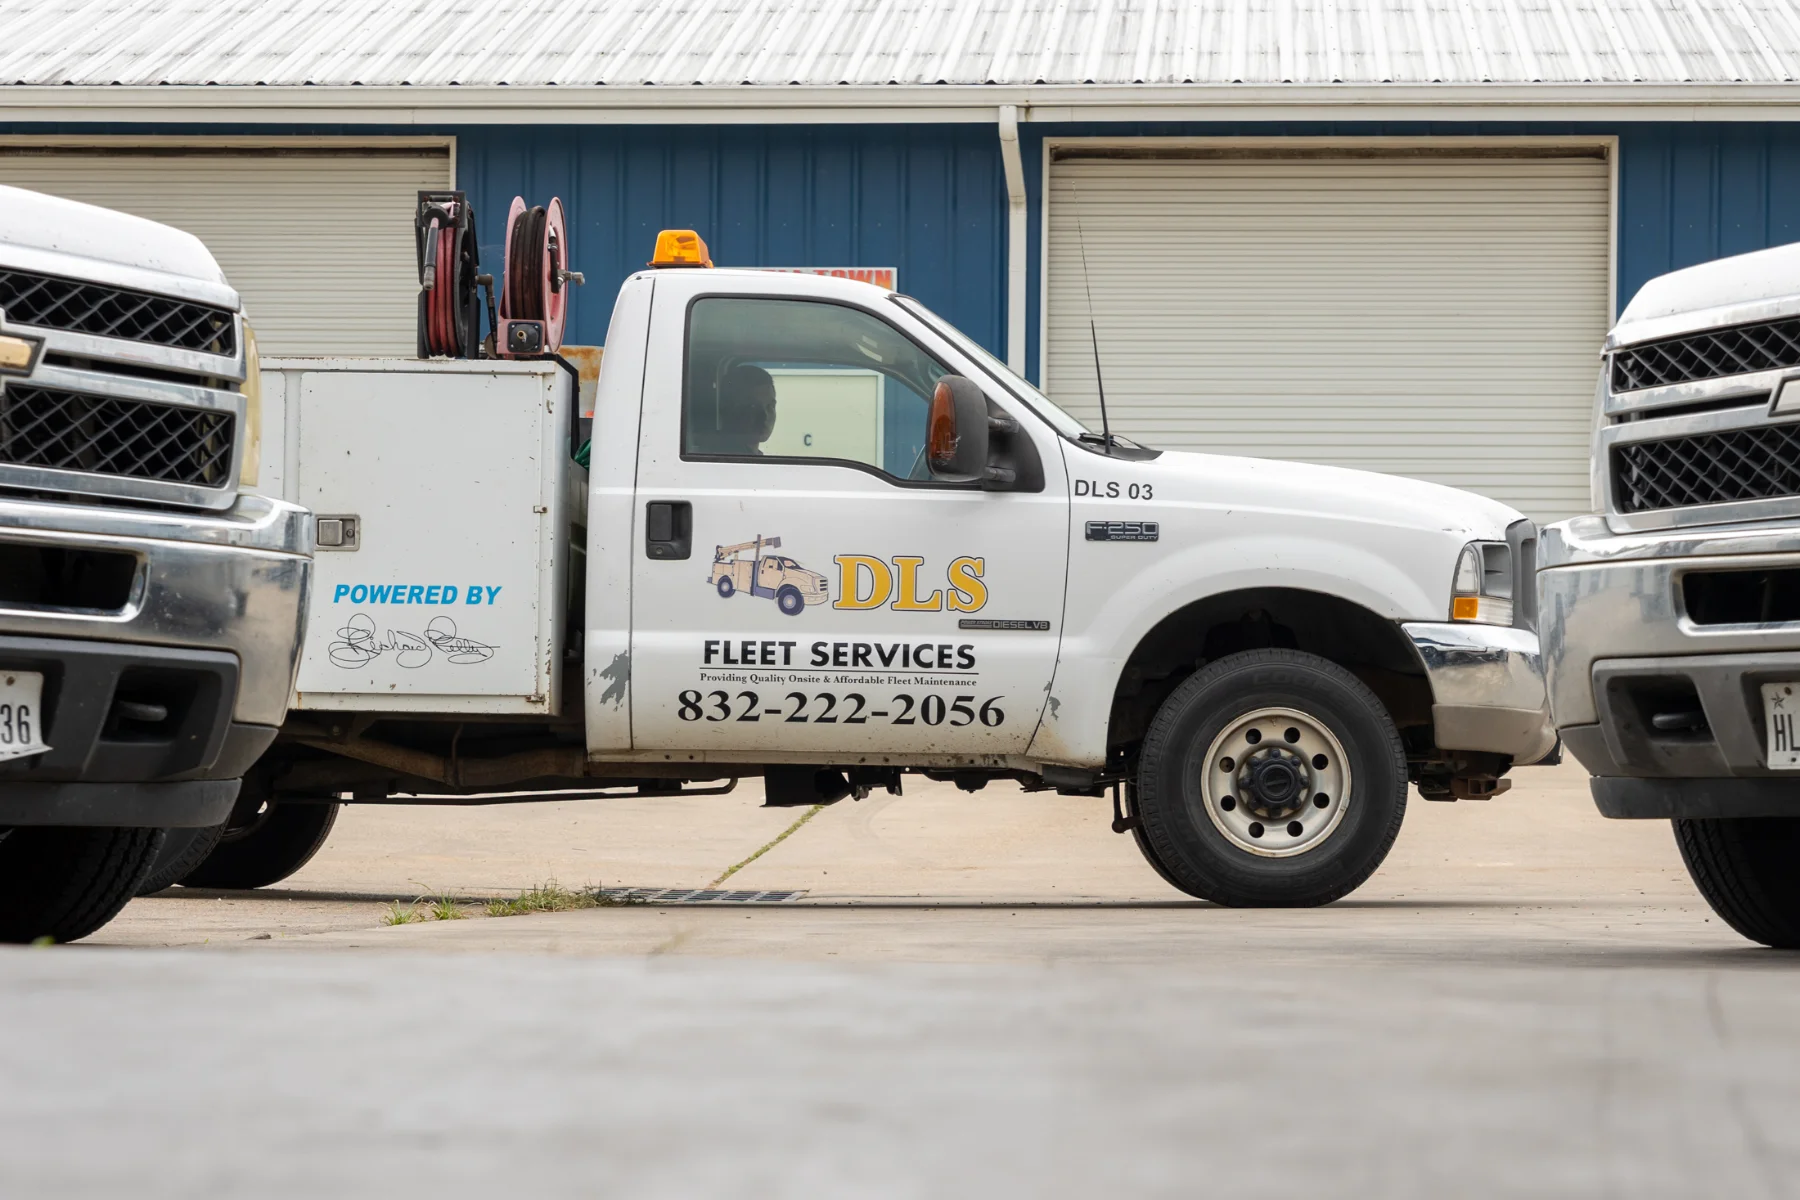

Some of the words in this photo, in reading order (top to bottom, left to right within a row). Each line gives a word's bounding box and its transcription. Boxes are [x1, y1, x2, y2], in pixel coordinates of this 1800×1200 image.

[803, 433, 812, 447] C
[1074, 479, 1120, 499] DLS
[1128, 483, 1153, 500] 03
[832, 554, 989, 614] DLS
[333, 584, 458, 604] POWERED
[465, 585, 503, 606] BY
[992, 620, 1032, 629] DIESEL
[1032, 621, 1049, 629] V8
[704, 640, 797, 666] FLEET
[810, 641, 976, 670] SERVICES
[699, 672, 748, 685] Providing
[749, 673, 787, 686] Quality
[788, 674, 821, 684] Onsite
[823, 675, 831, 684] &
[833, 675, 885, 686] Affordable
[887, 676, 912, 686] Fleet
[913, 677, 978, 687] Maintenance
[678, 690, 1005, 727] 832-222-2056
